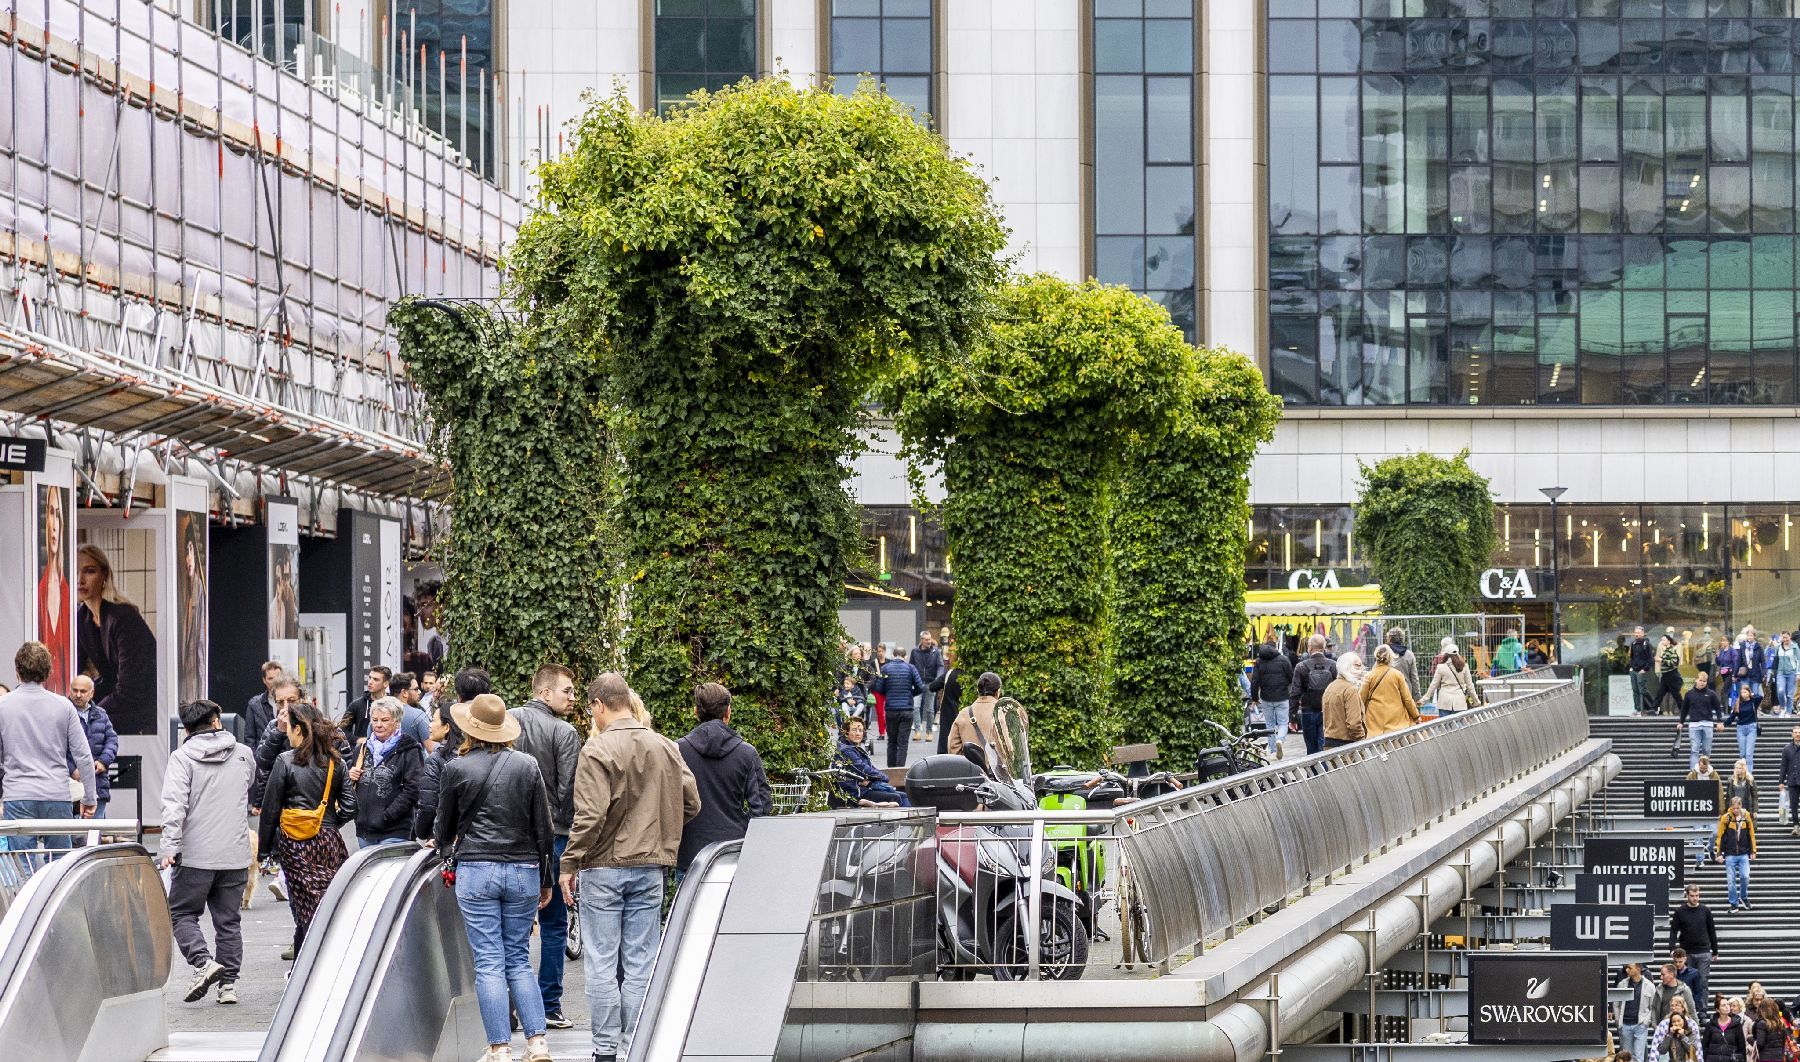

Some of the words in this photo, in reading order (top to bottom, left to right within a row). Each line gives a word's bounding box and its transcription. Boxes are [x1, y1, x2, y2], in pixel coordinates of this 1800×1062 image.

[1288, 568, 1341, 590] C&A
[1480, 568, 1537, 600] C&A
[1650, 785, 1685, 798] URBAN
[1650, 799, 1713, 812] OUTFITTERS
[1629, 846, 1676, 862] URBAN
[1598, 884, 1647, 905] WE
[1575, 915, 1630, 940] WE
[1479, 1005, 1595, 1023] SWAROVSKI
